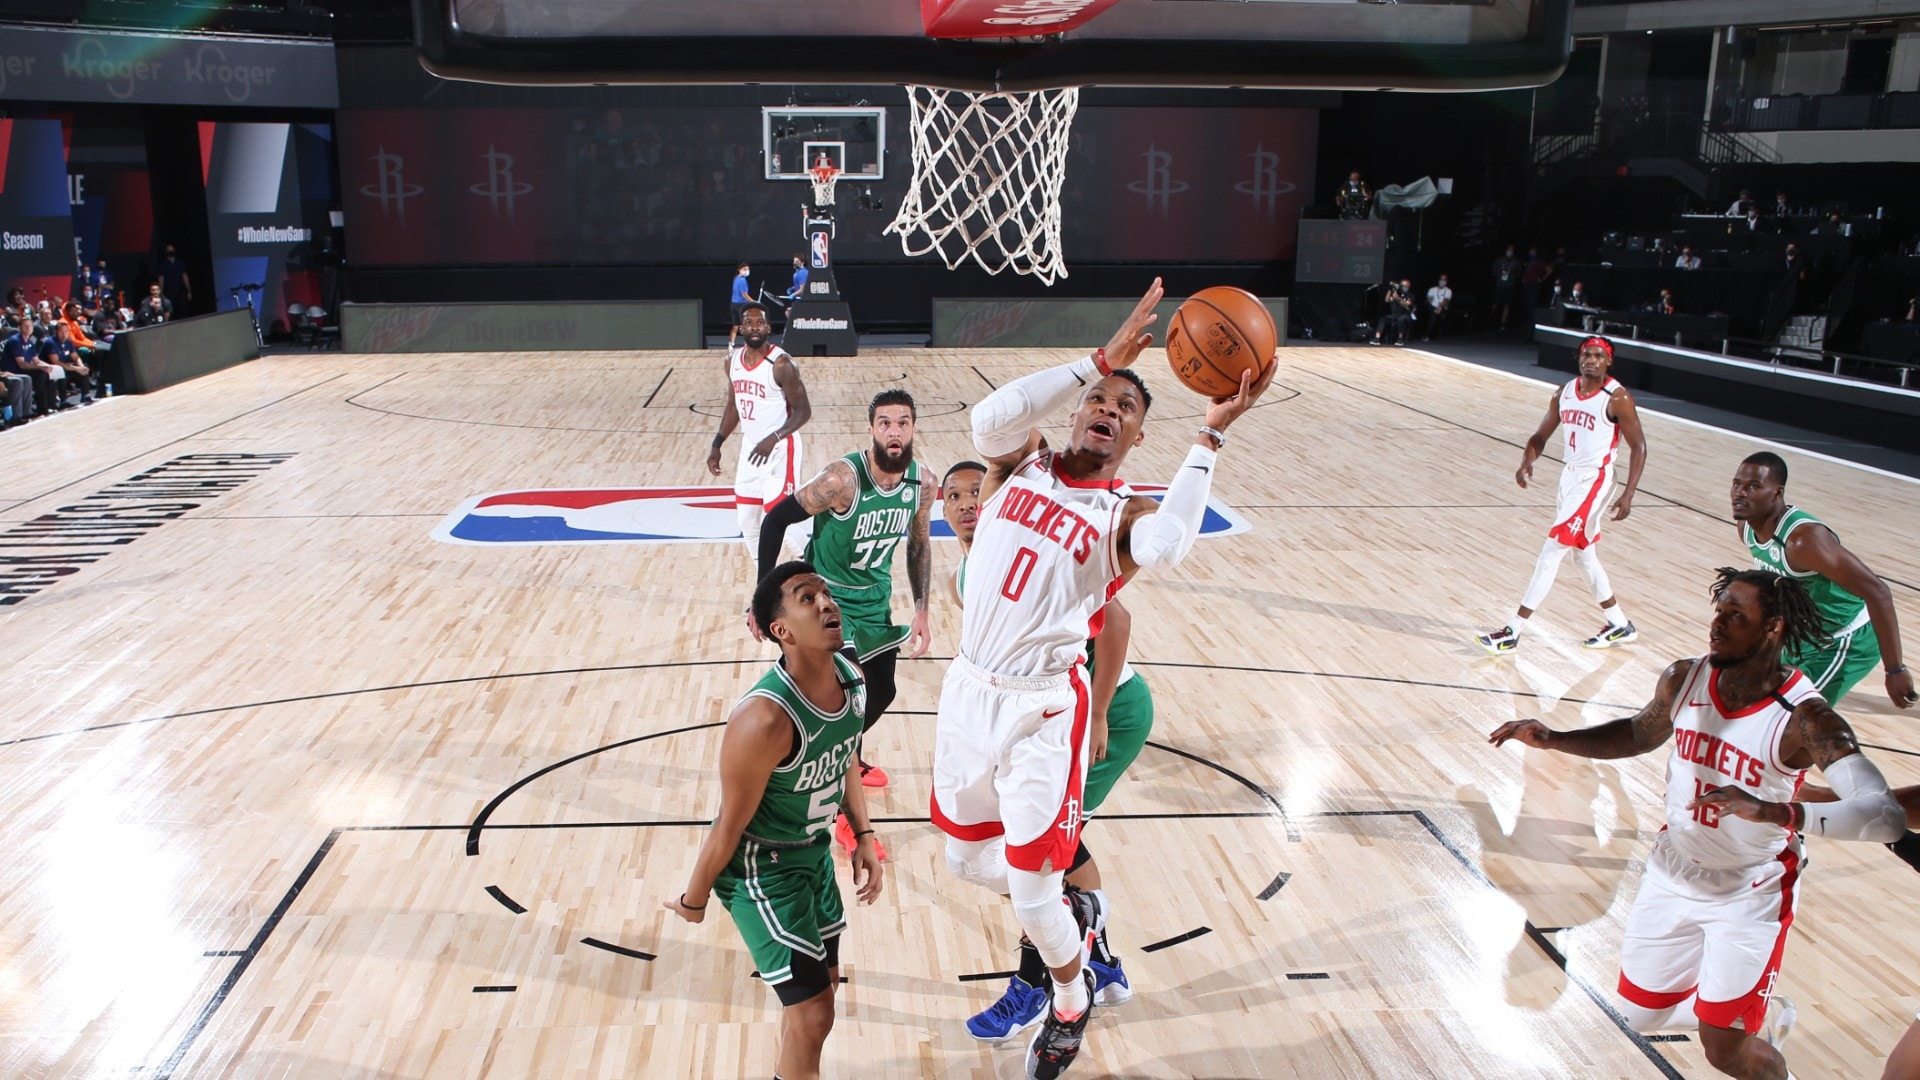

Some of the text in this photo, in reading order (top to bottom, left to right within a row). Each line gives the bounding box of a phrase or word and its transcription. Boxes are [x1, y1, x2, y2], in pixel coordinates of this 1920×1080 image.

[62, 39, 162, 99] Kroger
[184, 43, 277, 101] Kroger
[3, 231, 44, 250] Season
[238, 226, 312, 243] #WholeNewGame
[1356, 233, 1373, 247] 24
[1353, 263, 1371, 278] 23
[809, 281, 830, 294] @NBA
[792, 318, 848, 330] #WholeNewGame
[740, 399, 755, 420] 32
[1569, 431, 1576, 452] 4
[82, 452, 300, 500] MATTER
[852, 508, 912, 540] BOSTON
[996, 486, 1101, 565] ROCKETS
[850, 536, 900, 571] 77
[1001, 547, 1039, 602] 0
